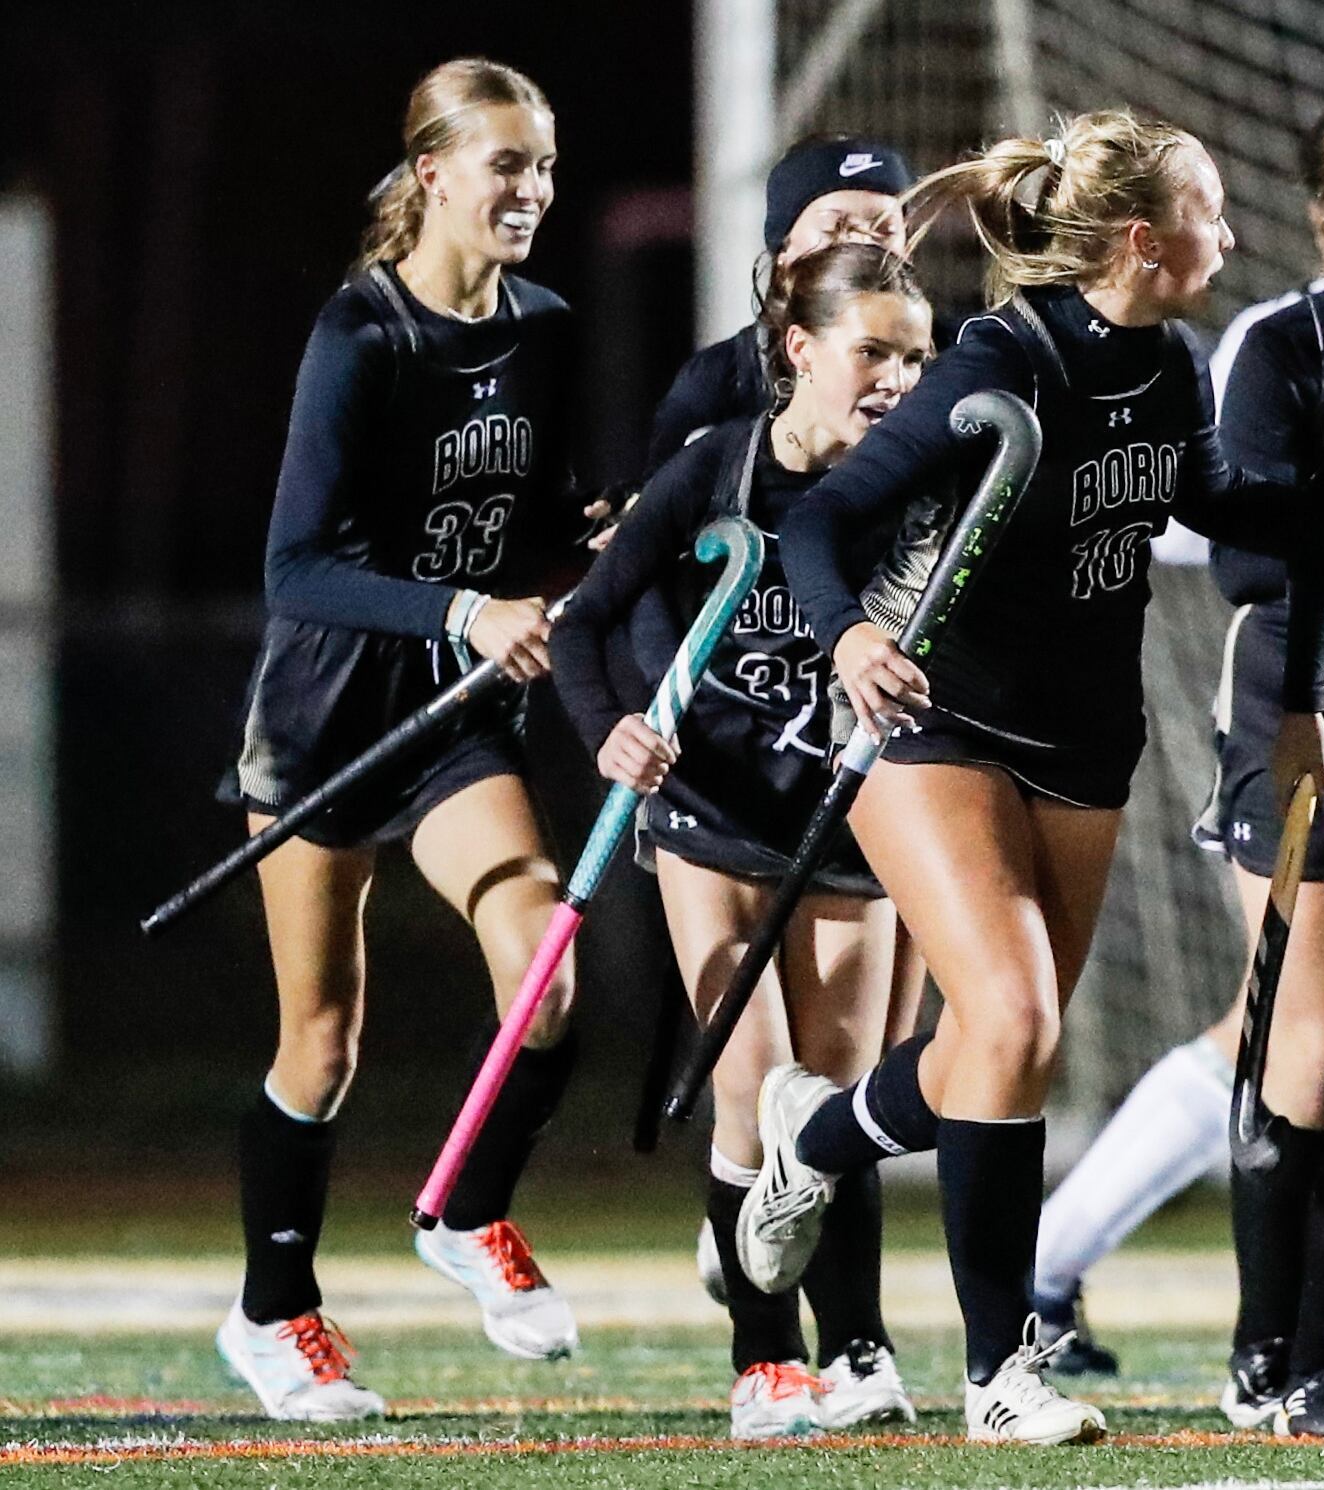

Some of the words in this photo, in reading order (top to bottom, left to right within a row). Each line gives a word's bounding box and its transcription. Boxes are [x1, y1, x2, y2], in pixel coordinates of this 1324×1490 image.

[432, 414, 534, 495] BORO
[1070, 443, 1178, 527] BORO
[412, 493, 515, 581] 33
